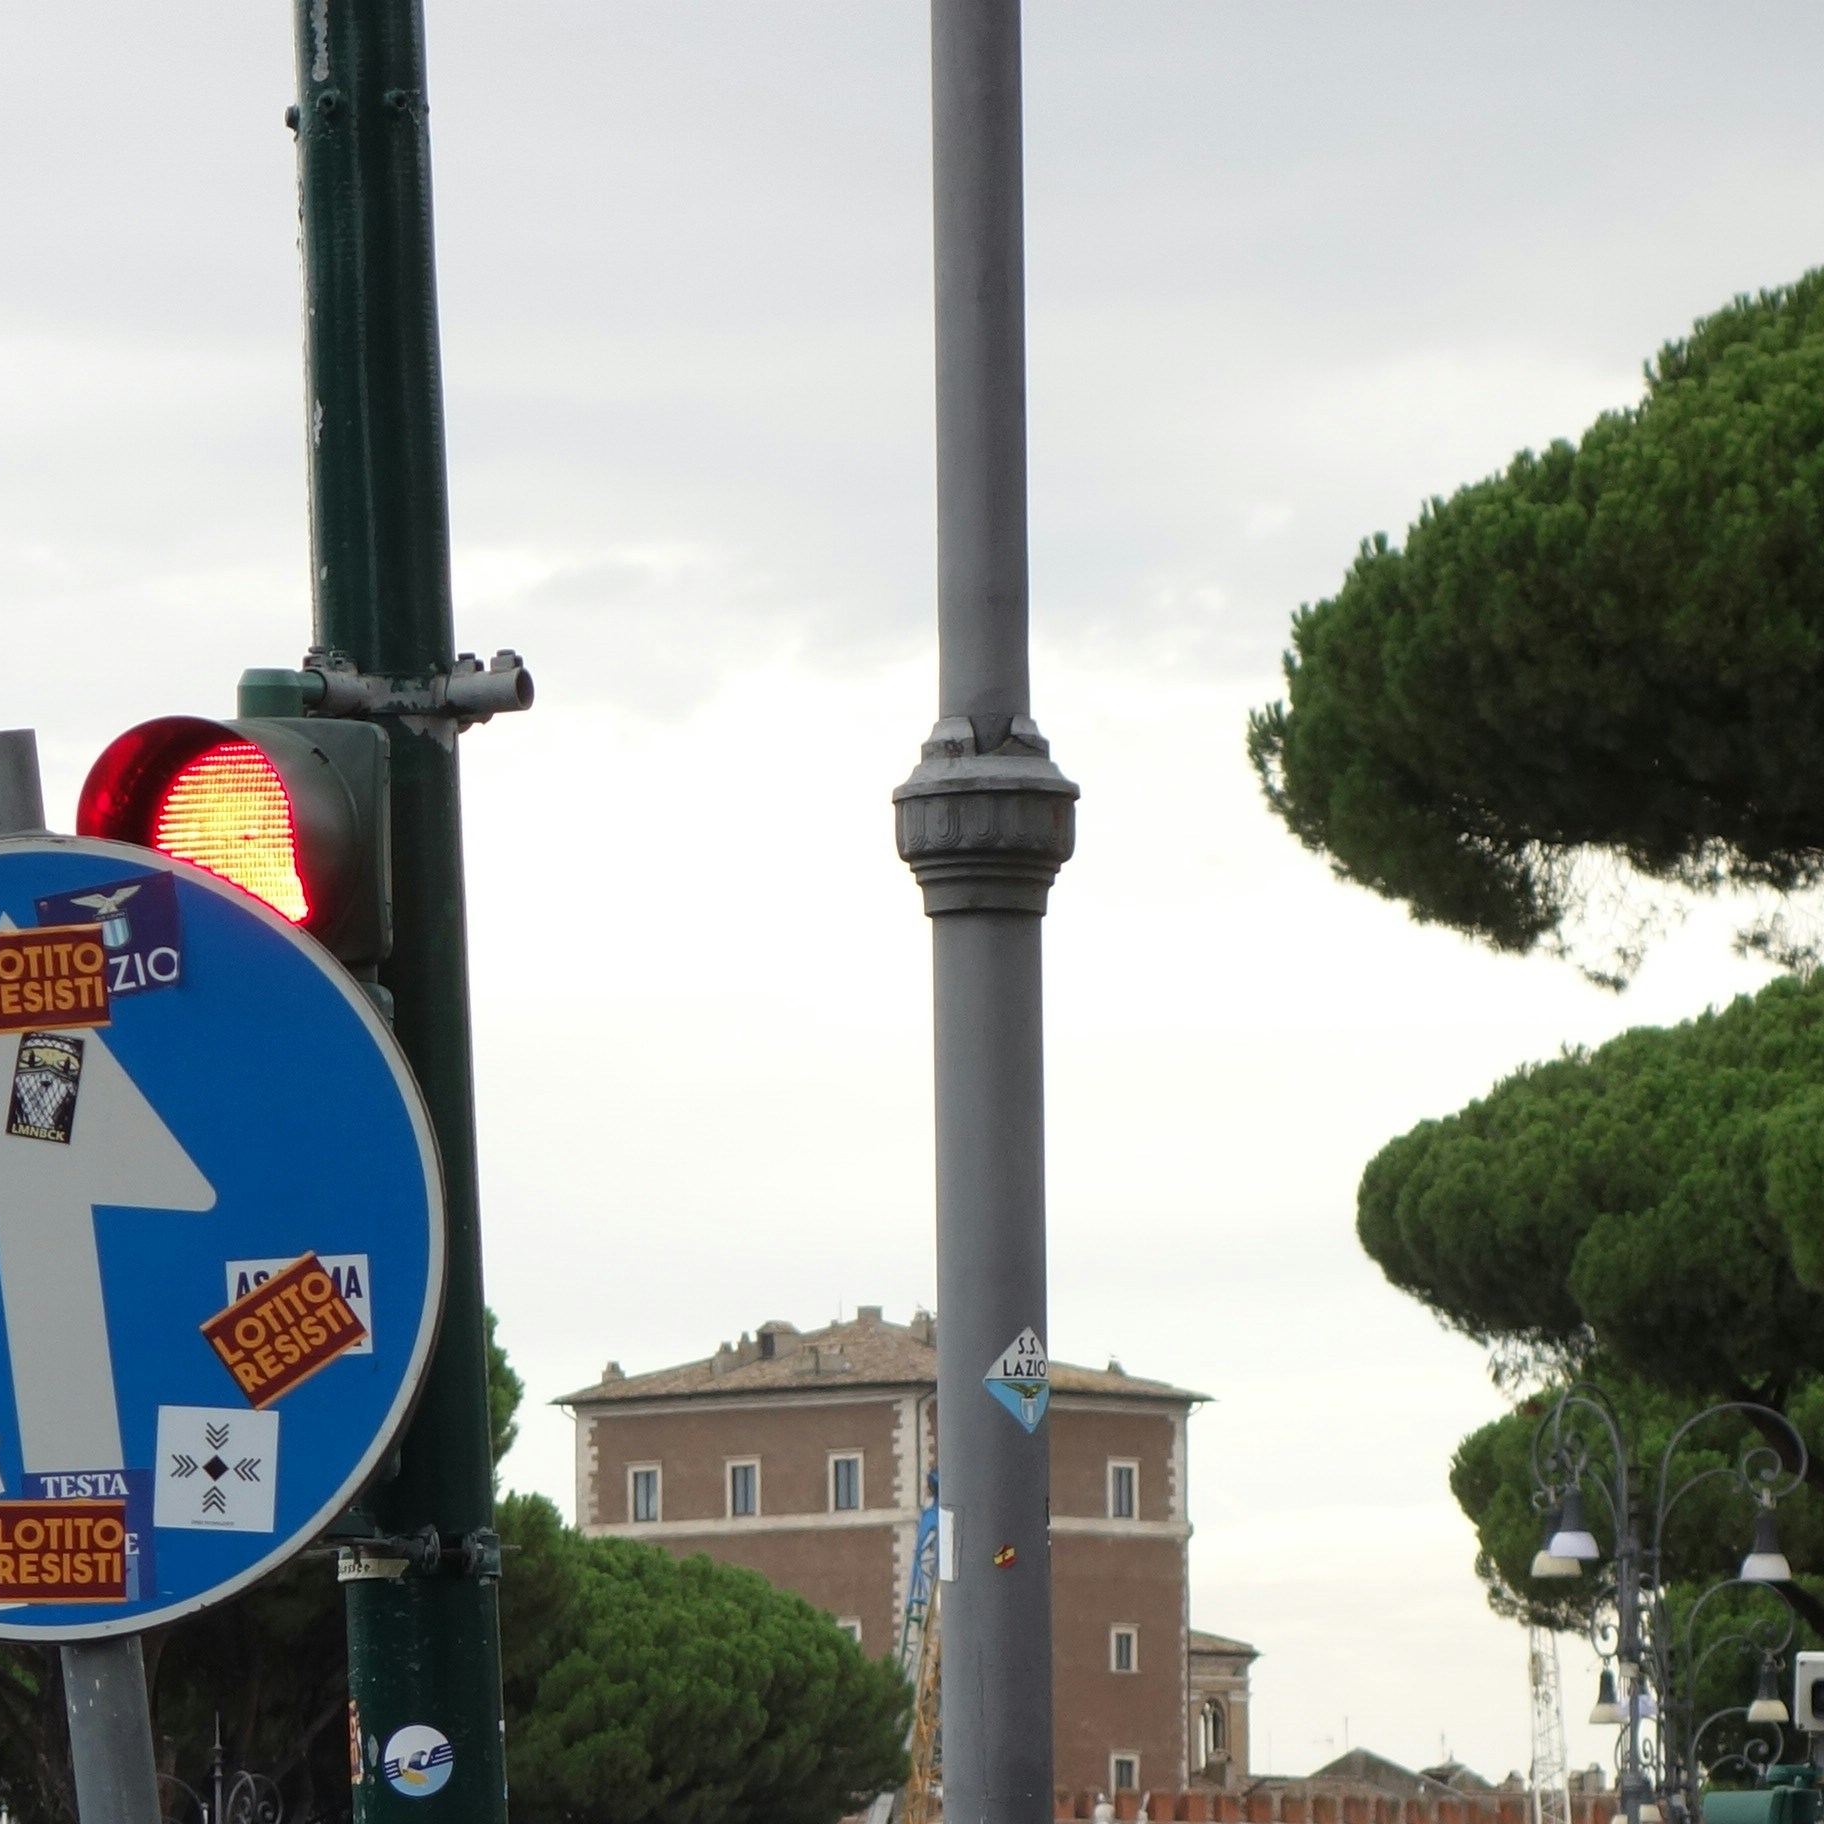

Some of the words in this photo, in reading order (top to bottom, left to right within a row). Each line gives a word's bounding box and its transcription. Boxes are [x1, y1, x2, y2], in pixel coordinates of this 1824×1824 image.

[107, 946, 178, 993] ZIO
[213, 1271, 332, 1366] LOTITO
[234, 1299, 353, 1393] RESISTI
[1018, 1337, 1038, 1354] S.S.
[1003, 1360, 1046, 1377] LAZIO
[40, 1473, 129, 1499] TESTA
